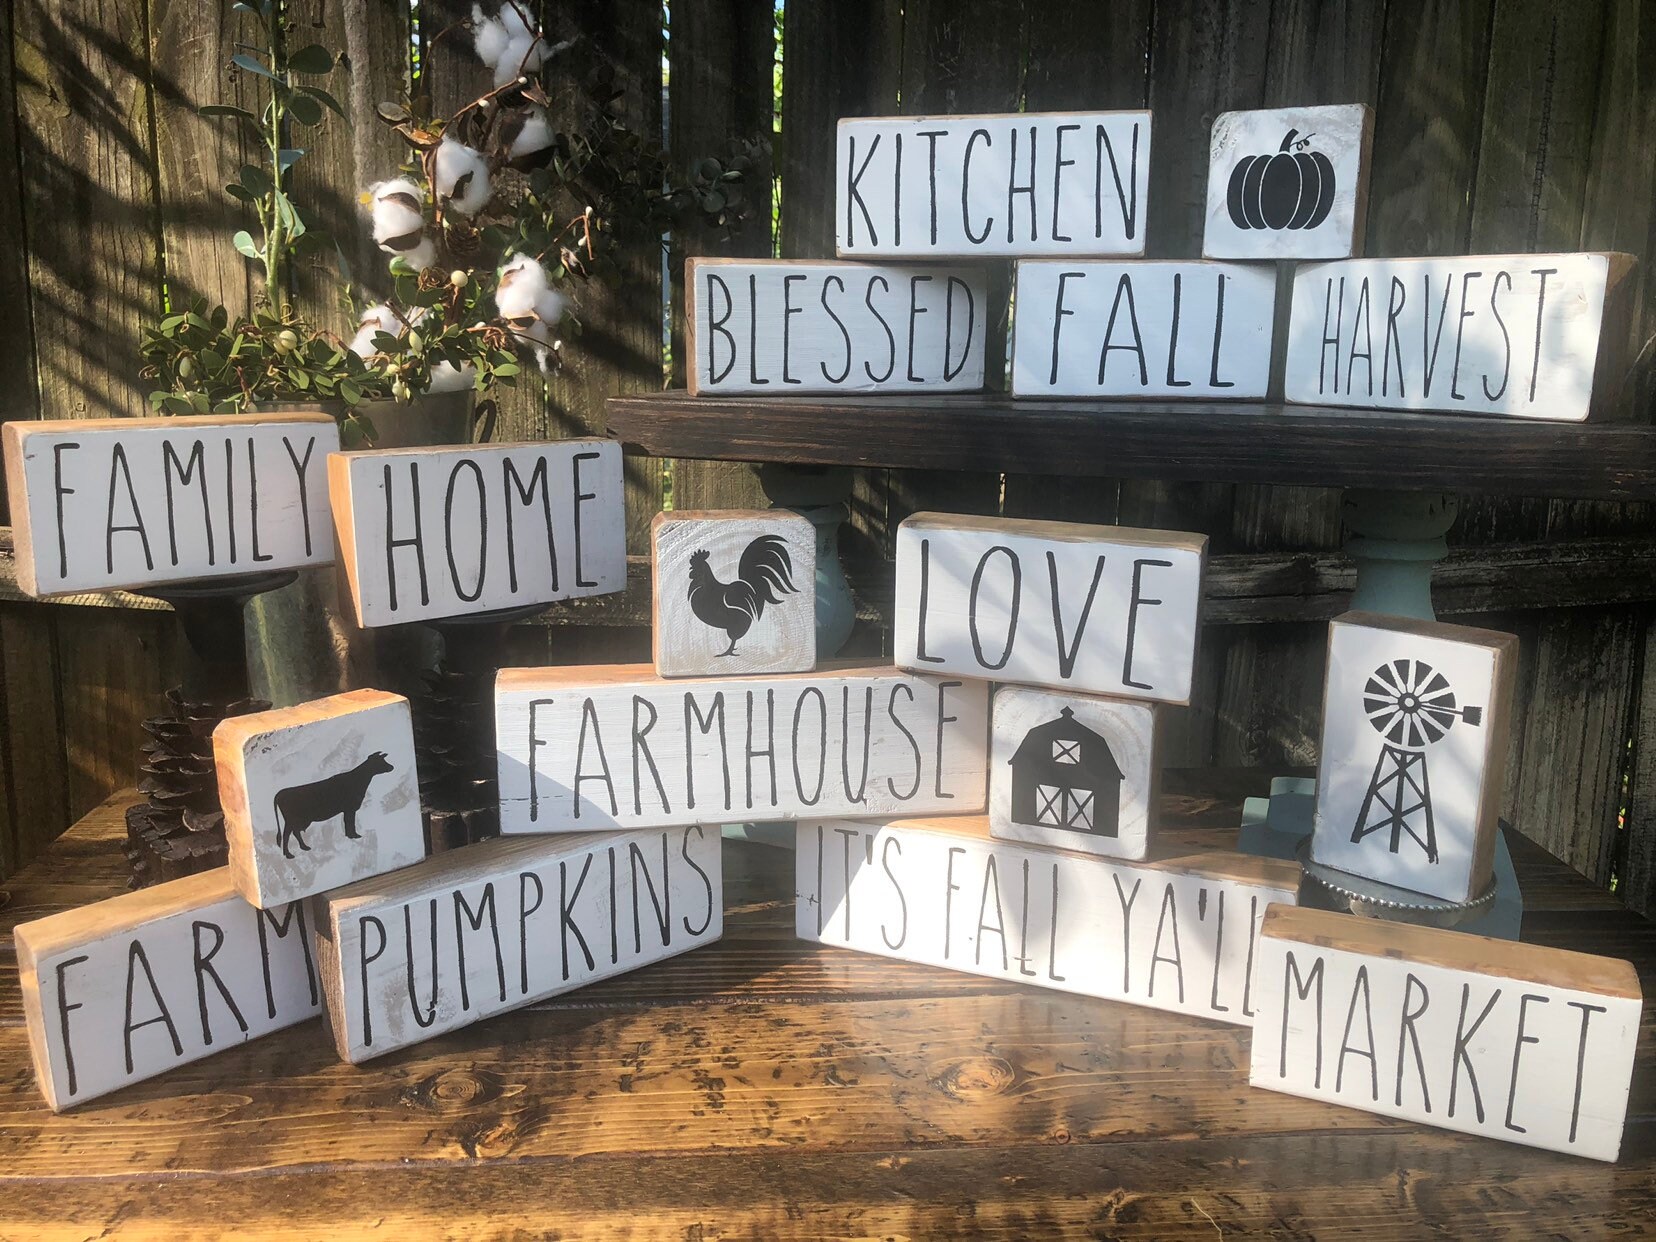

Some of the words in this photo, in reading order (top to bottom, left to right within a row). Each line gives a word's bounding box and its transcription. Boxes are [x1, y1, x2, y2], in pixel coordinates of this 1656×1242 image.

[847, 122, 1139, 247] KITCHEN
[706, 273, 975, 384] BLESSED
[1050, 272, 1235, 388] FALL
[1319, 268, 1557, 402] HARVEST
[53, 435, 316, 578] FAMILY
[383, 452, 601, 611] HOME
[916, 538, 1174, 690] LOVE
[529, 681, 963, 822] FARMHOUSE
[359, 825, 714, 1047] PUMPKINS
[817, 825, 908, 950] IT'S
[944, 847, 1066, 982] FALL
[1113, 873, 1255, 1017] YA'LL
[56, 900, 319, 1096] FARM
[1279, 951, 1607, 1143] MARKET
